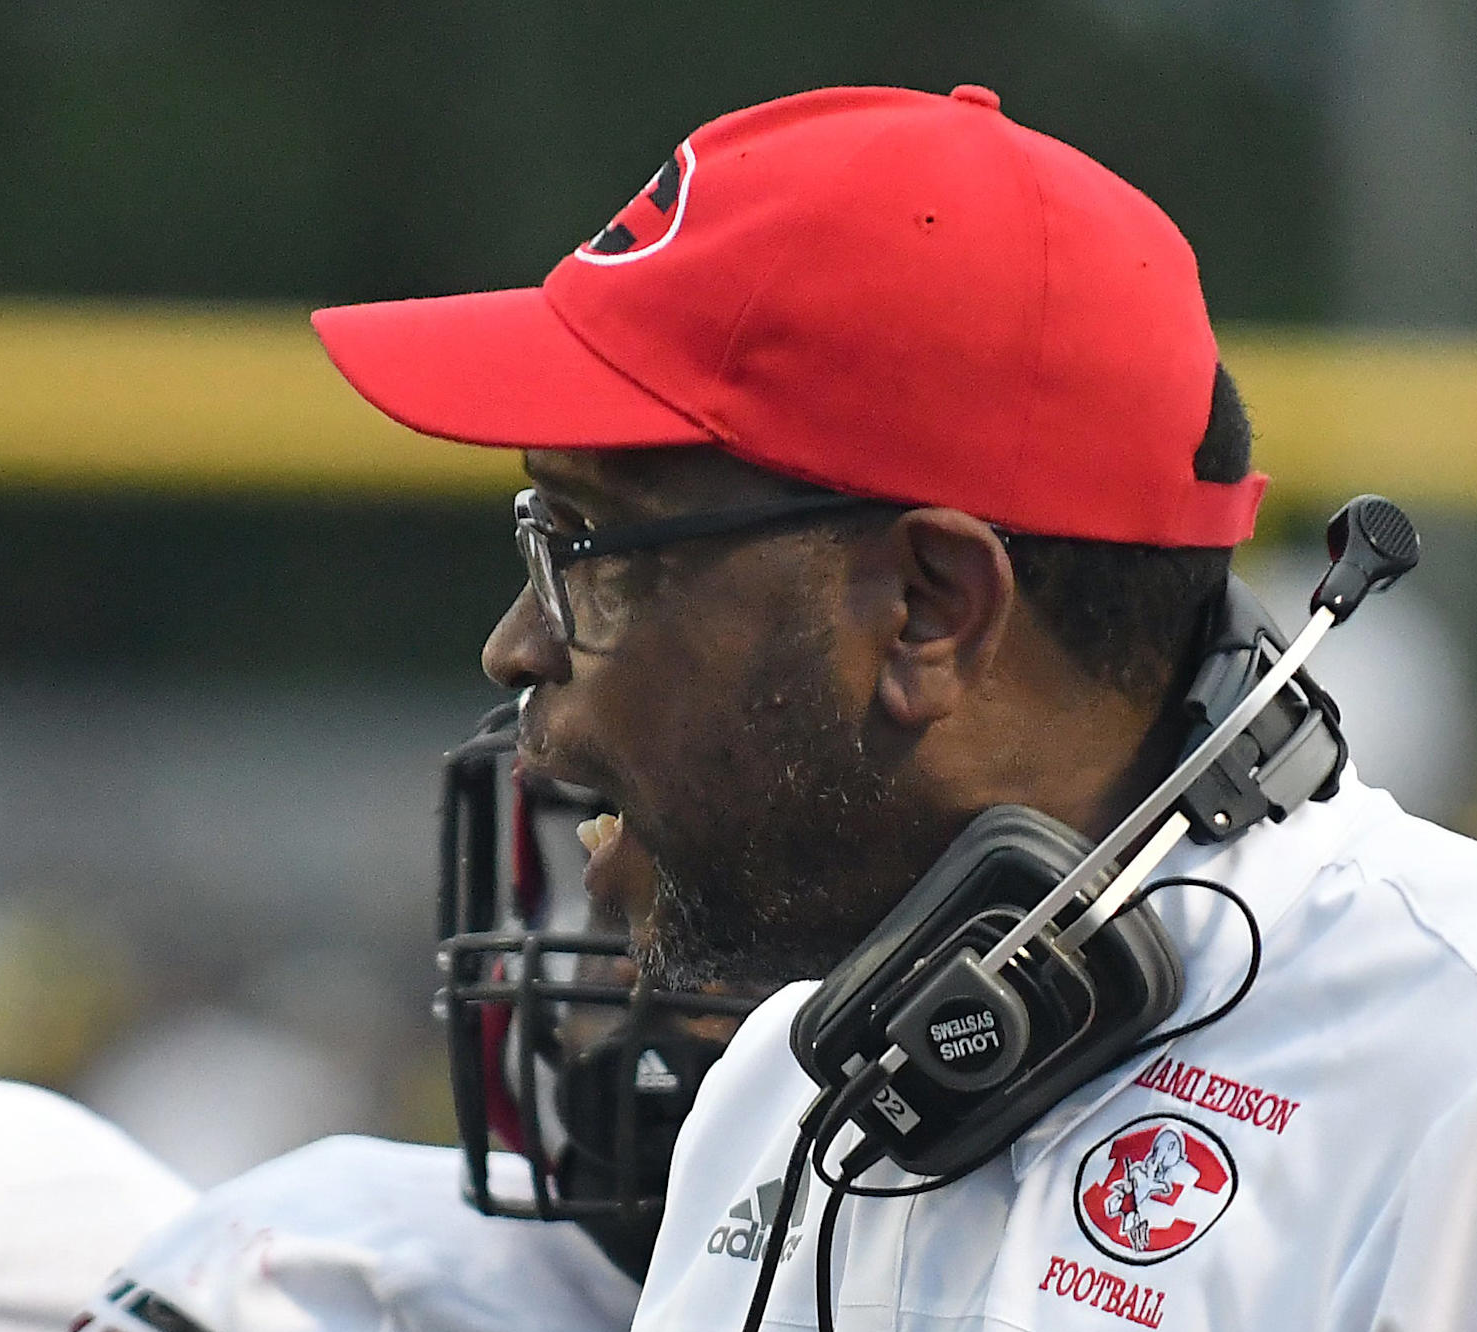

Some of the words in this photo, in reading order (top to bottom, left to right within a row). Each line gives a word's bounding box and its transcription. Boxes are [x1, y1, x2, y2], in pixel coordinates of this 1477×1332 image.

[930, 1010, 994, 1041] SYSTEMS
[940, 1031, 999, 1061] LOUIS
[1195, 1072, 1300, 1135] EDISON
[1038, 1255, 1166, 1329] FOOTBALL
